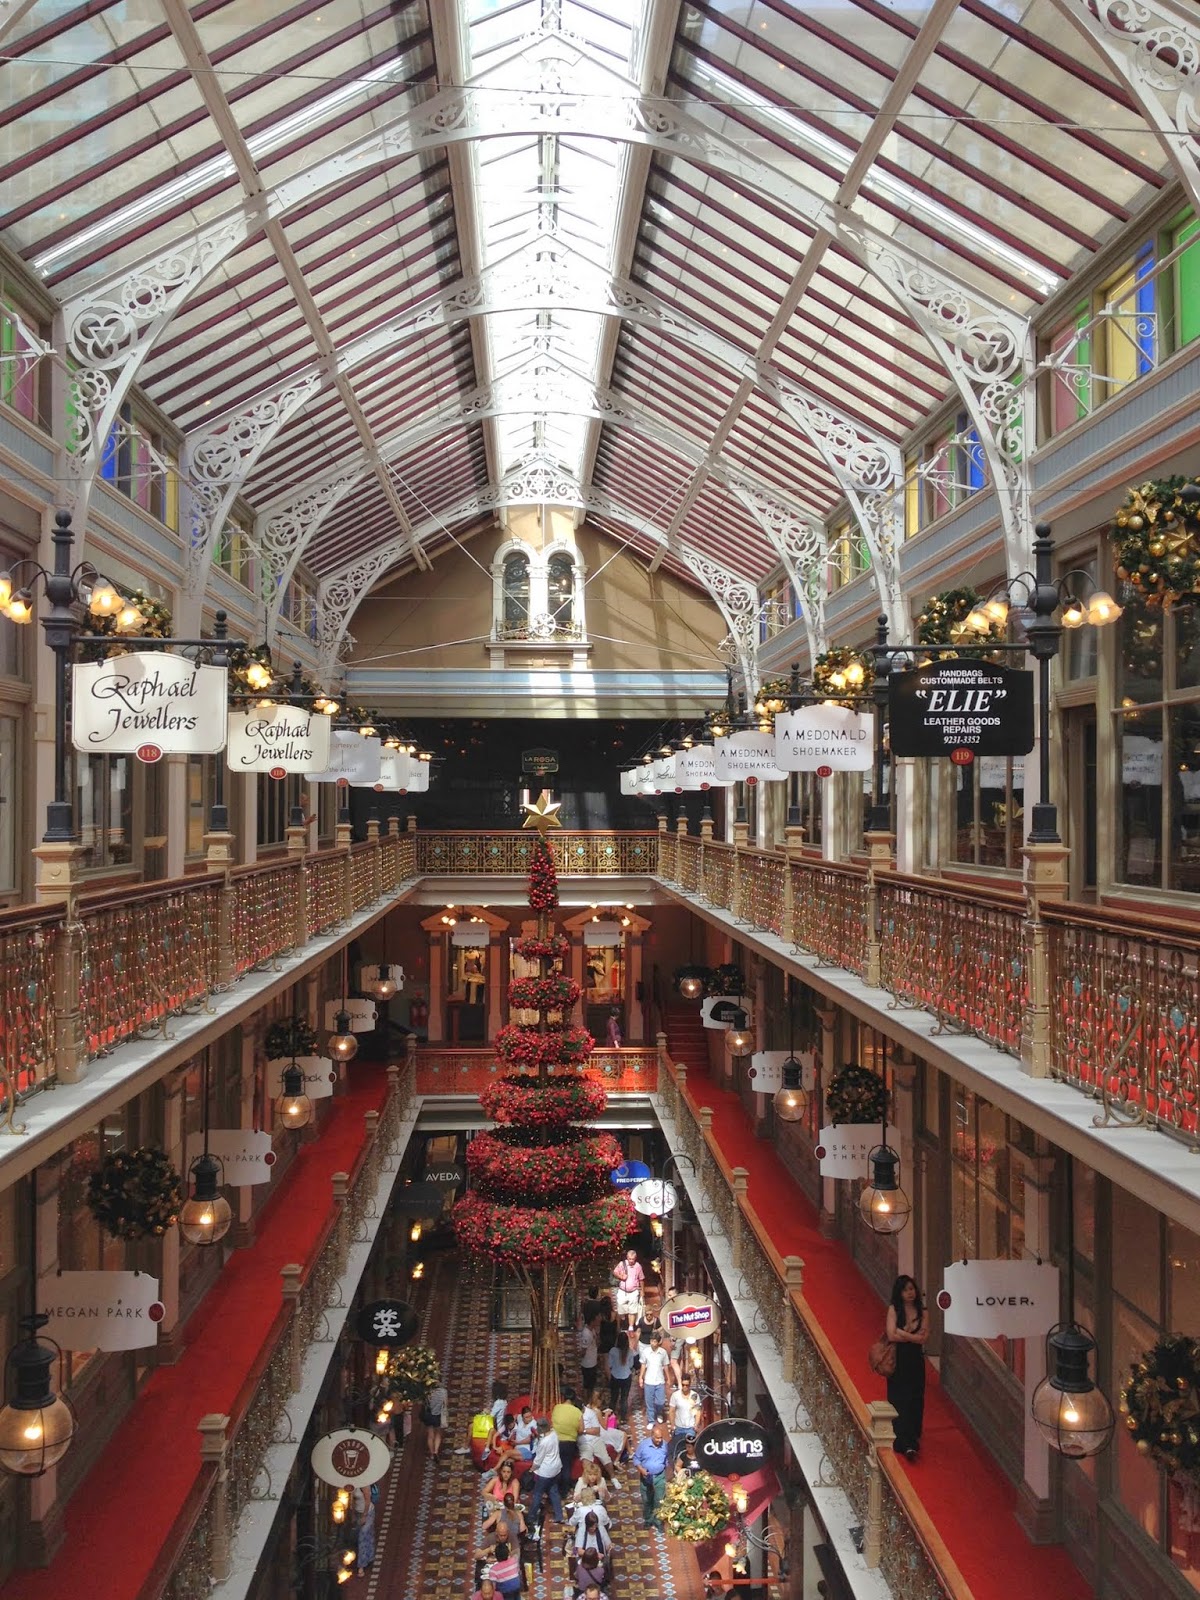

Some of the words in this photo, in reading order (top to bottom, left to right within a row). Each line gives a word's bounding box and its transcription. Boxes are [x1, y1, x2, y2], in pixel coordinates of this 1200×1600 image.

[920, 677, 976, 685] CUSTOMMADE
[977, 676, 1003, 685] BELTS
[88, 701, 199, 742] Jewellers
[924, 717, 965, 726] LEATHER
[967, 717, 1000, 726] GOODS
[943, 725, 982, 734] REPAIRS
[783, 730, 790, 740] A
[943, 735, 980, 744] 9231-3352
[140, 748, 157, 758] 118
[241, 741, 313, 765] Jewellers
[720, 749, 726, 757] A
[730, 749, 775, 758] McDONAL
[793, 746, 857, 756] SHOEMAKER
[956, 752, 969, 760] 119
[236, 1154, 261, 1162] PARK
[426, 1172, 460, 1181] AVEDA
[976, 1297, 1034, 1306] LOVER.
[44, 1307, 99, 1318] MEGAN
[107, 1307, 142, 1318] PARK
[672, 1315, 683, 1323] The
[684, 1313, 694, 1322] Nut
[694, 1311, 709, 1320] Shop
[704, 1437, 763, 1455] dustins
